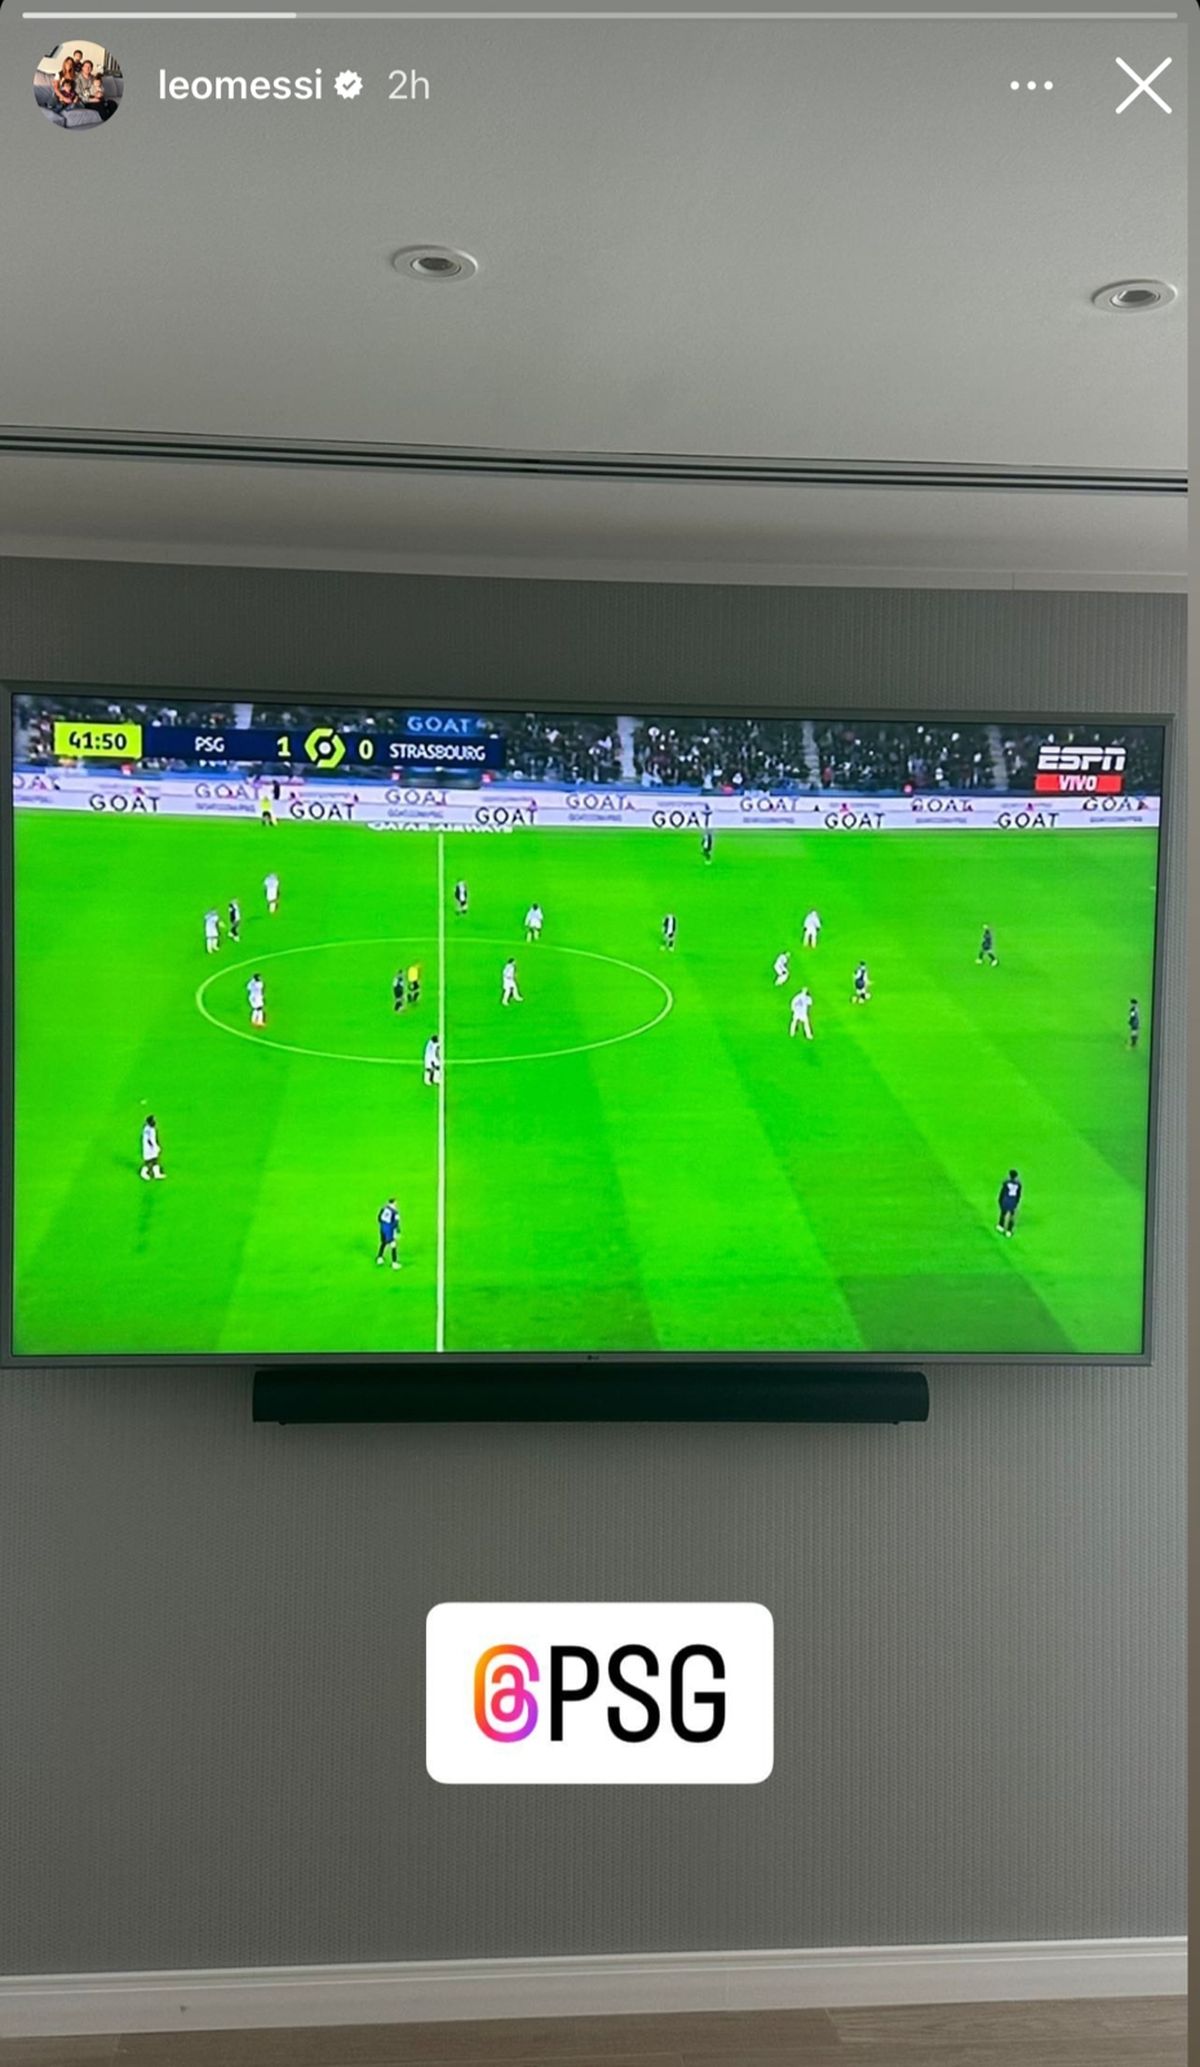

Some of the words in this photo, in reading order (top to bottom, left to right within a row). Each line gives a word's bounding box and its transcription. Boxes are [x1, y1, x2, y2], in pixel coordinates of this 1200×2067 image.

[407, 716, 471, 733] GOAT
[68, 731, 127, 751] 41:50
[194, 736, 225, 753] PSG
[277, 736, 291, 756] 1
[358, 739, 374, 760] 0
[389, 743, 486, 761] STRASBOURG
[1037, 746, 1126, 771] ESPN
[195, 782, 261, 800] GOAT
[1058, 775, 1098, 791] VIVO
[89, 793, 160, 812] GOAT
[385, 788, 447, 806] GOAT
[566, 793, 627, 811] GOAT
[740, 796, 798, 812] GOAT
[289, 801, 354, 820] GOAT
[475, 807, 538, 825] GOAT
[652, 810, 713, 828] GOAT
[825, 812, 885, 829] GOAT
[998, 812, 1059, 829] GOAT
